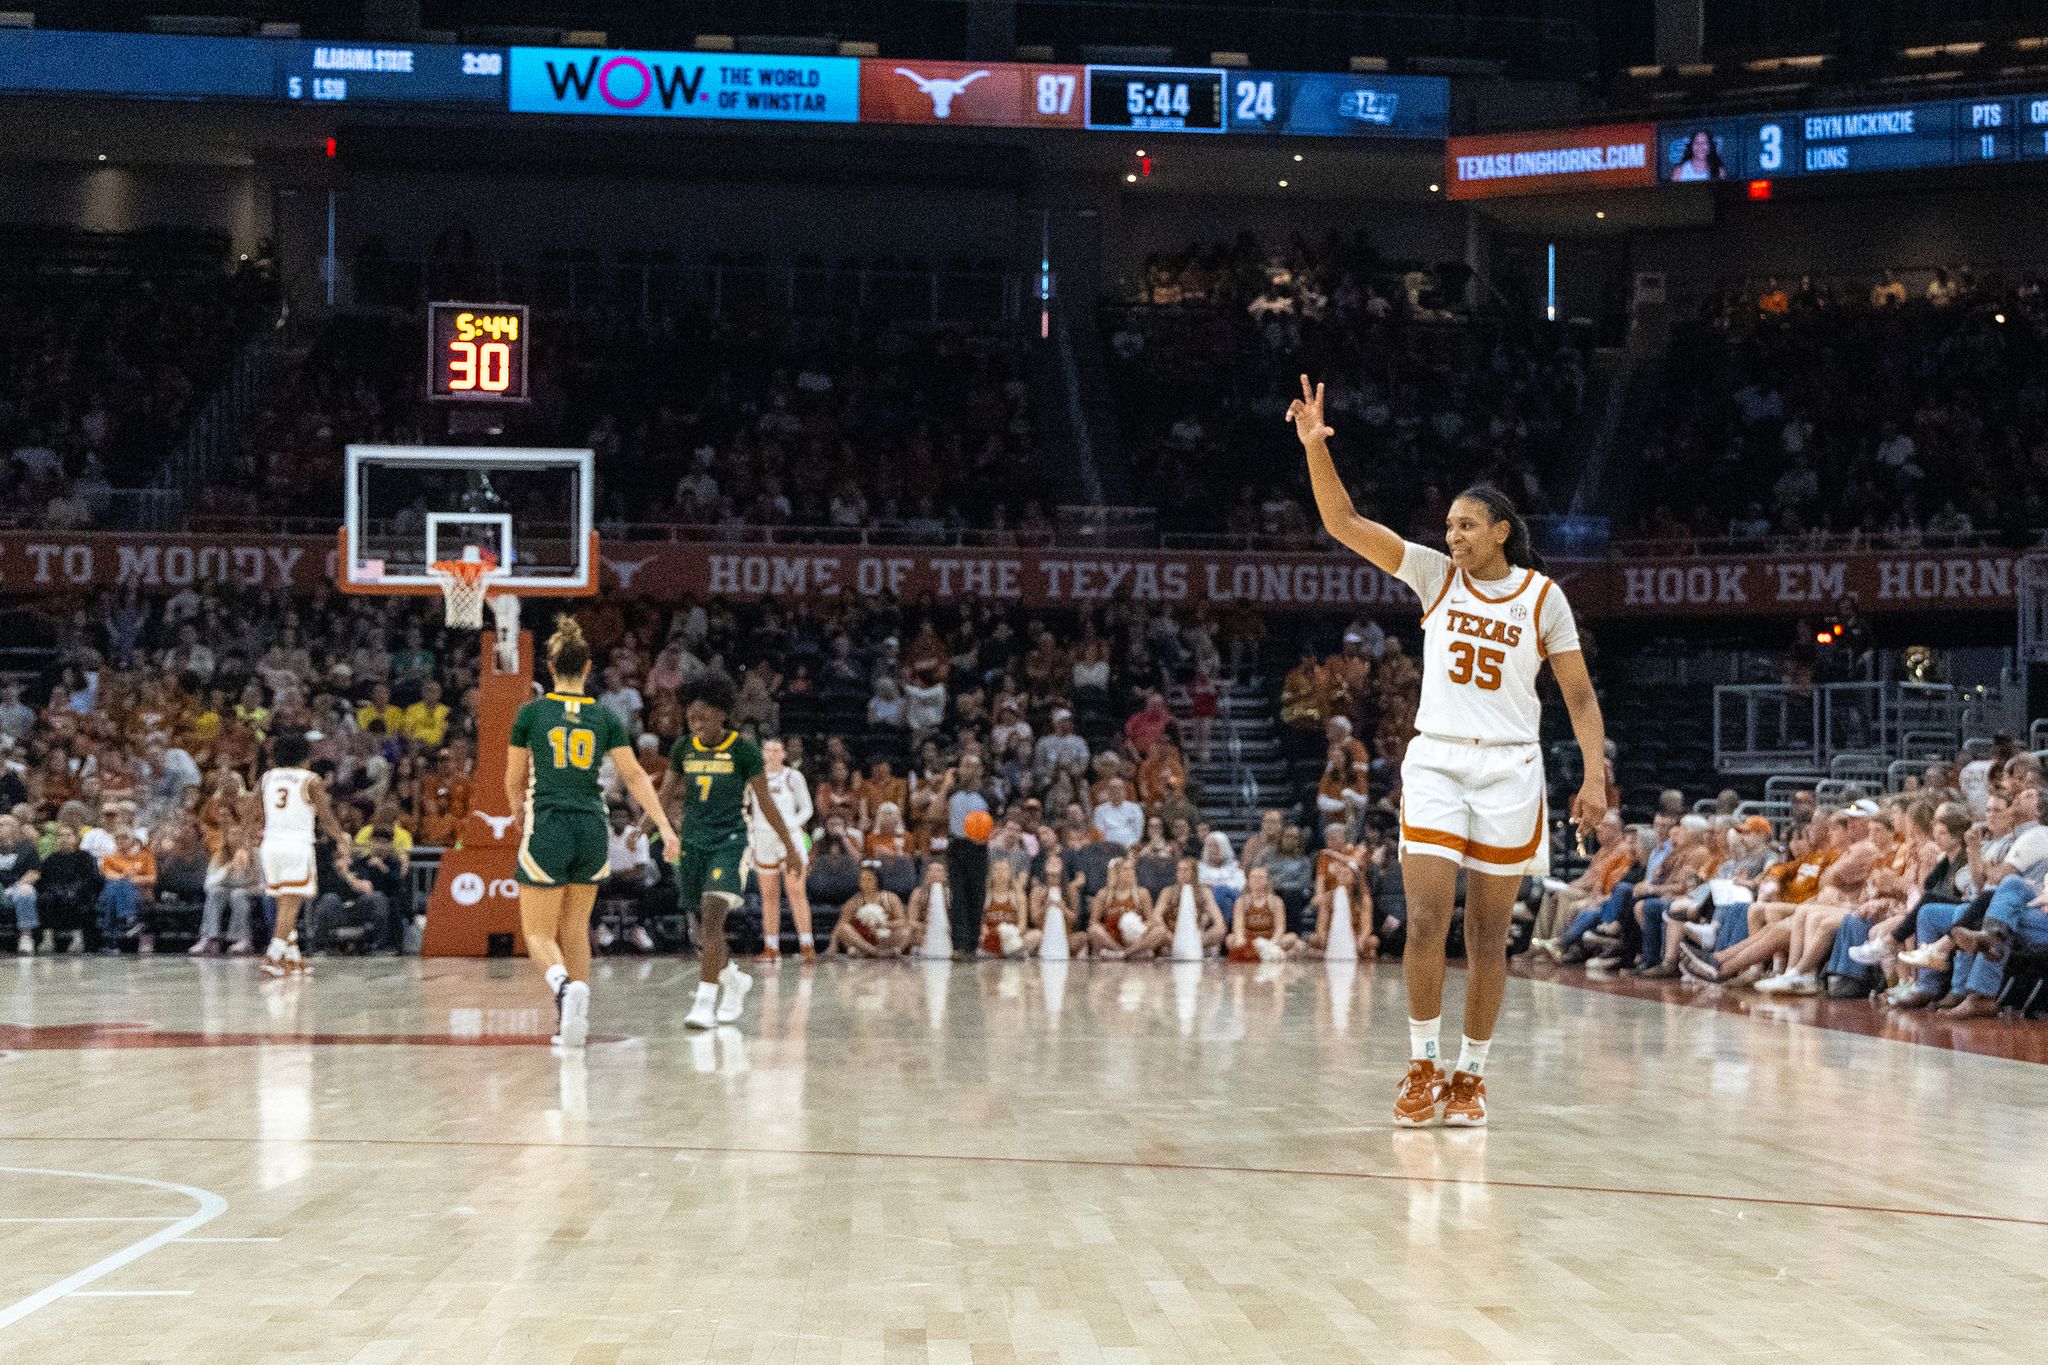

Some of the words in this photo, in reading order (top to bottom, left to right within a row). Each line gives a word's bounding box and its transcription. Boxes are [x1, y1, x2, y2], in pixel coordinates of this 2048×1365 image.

[719, 66, 753, 86] THE
[758, 68, 820, 88] WORLD
[1036, 75, 1077, 116] 87
[719, 90, 740, 109] OF
[744, 91, 827, 112] WINSTAR
[1126, 82, 1191, 117] 5:44
[1236, 80, 1277, 121] 24
[1972, 103, 2001, 129] PTS
[1804, 114, 1844, 141] ERYN
[1456, 143, 1647, 182] TEXASLONGHORNS.COM
[1759, 123, 1783, 172] 3
[1805, 145, 1850, 172] LIONS
[1979, 133, 1995, 160] 11
[456, 312, 519, 341] 5:44
[449, 341, 510, 391] 30
[25, 544, 94, 584] TO
[116, 545, 304, 586] MOODY
[708, 555, 841, 596] HOME
[856, 558, 915, 597] OF
[928, 559, 1023, 598] THE
[1038, 560, 1188, 601] TEXAS
[1624, 565, 1747, 606] HOOK
[1447, 608, 1523, 648] TEXAS
[1448, 640, 1507, 692] 35
[548, 726, 596, 770] 10
[275, 786, 290, 811] 3
[695, 775, 713, 802] 7
[488, 878, 520, 898] ra
